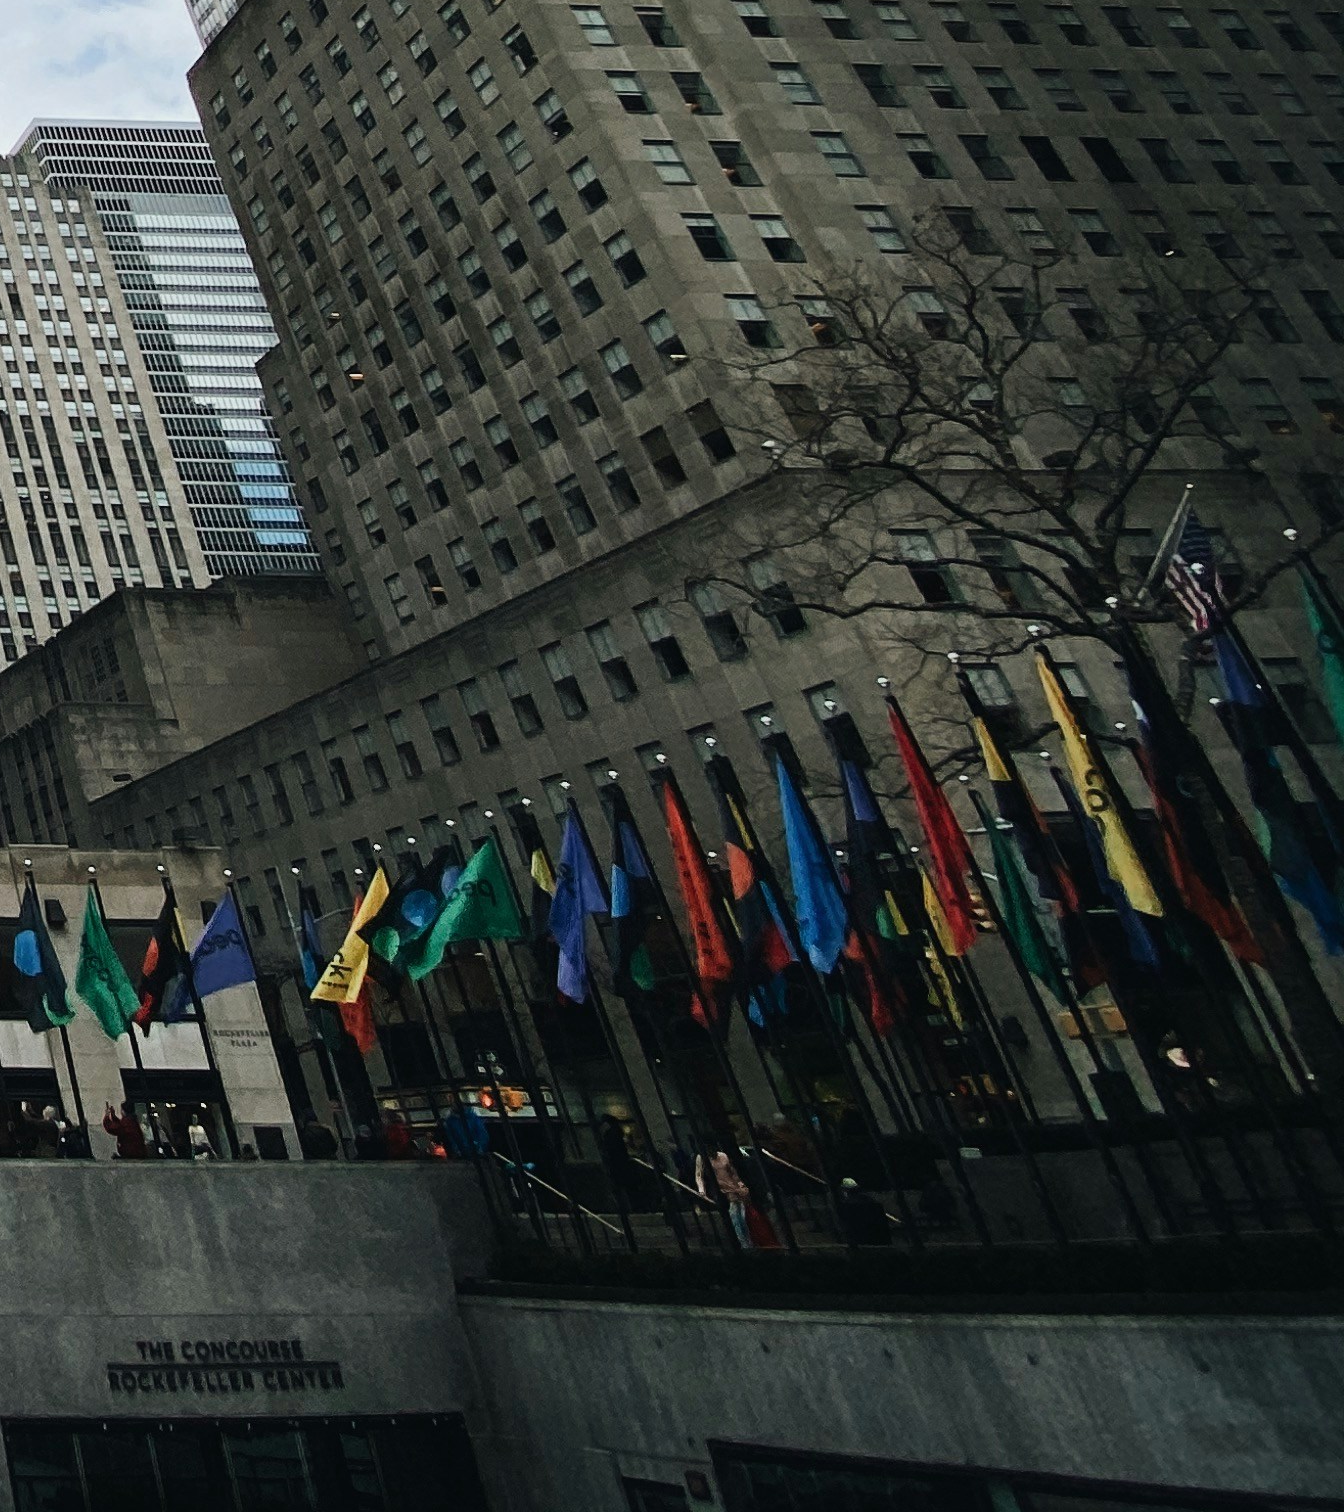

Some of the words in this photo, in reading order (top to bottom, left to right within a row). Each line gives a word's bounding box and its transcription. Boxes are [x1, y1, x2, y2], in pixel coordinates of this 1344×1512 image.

[136, 1341, 175, 1360] THE
[181, 1339, 304, 1360] CONCOURSE
[108, 1370, 255, 1393] ROCKEFELLER
[263, 1368, 346, 1391] CENTER
